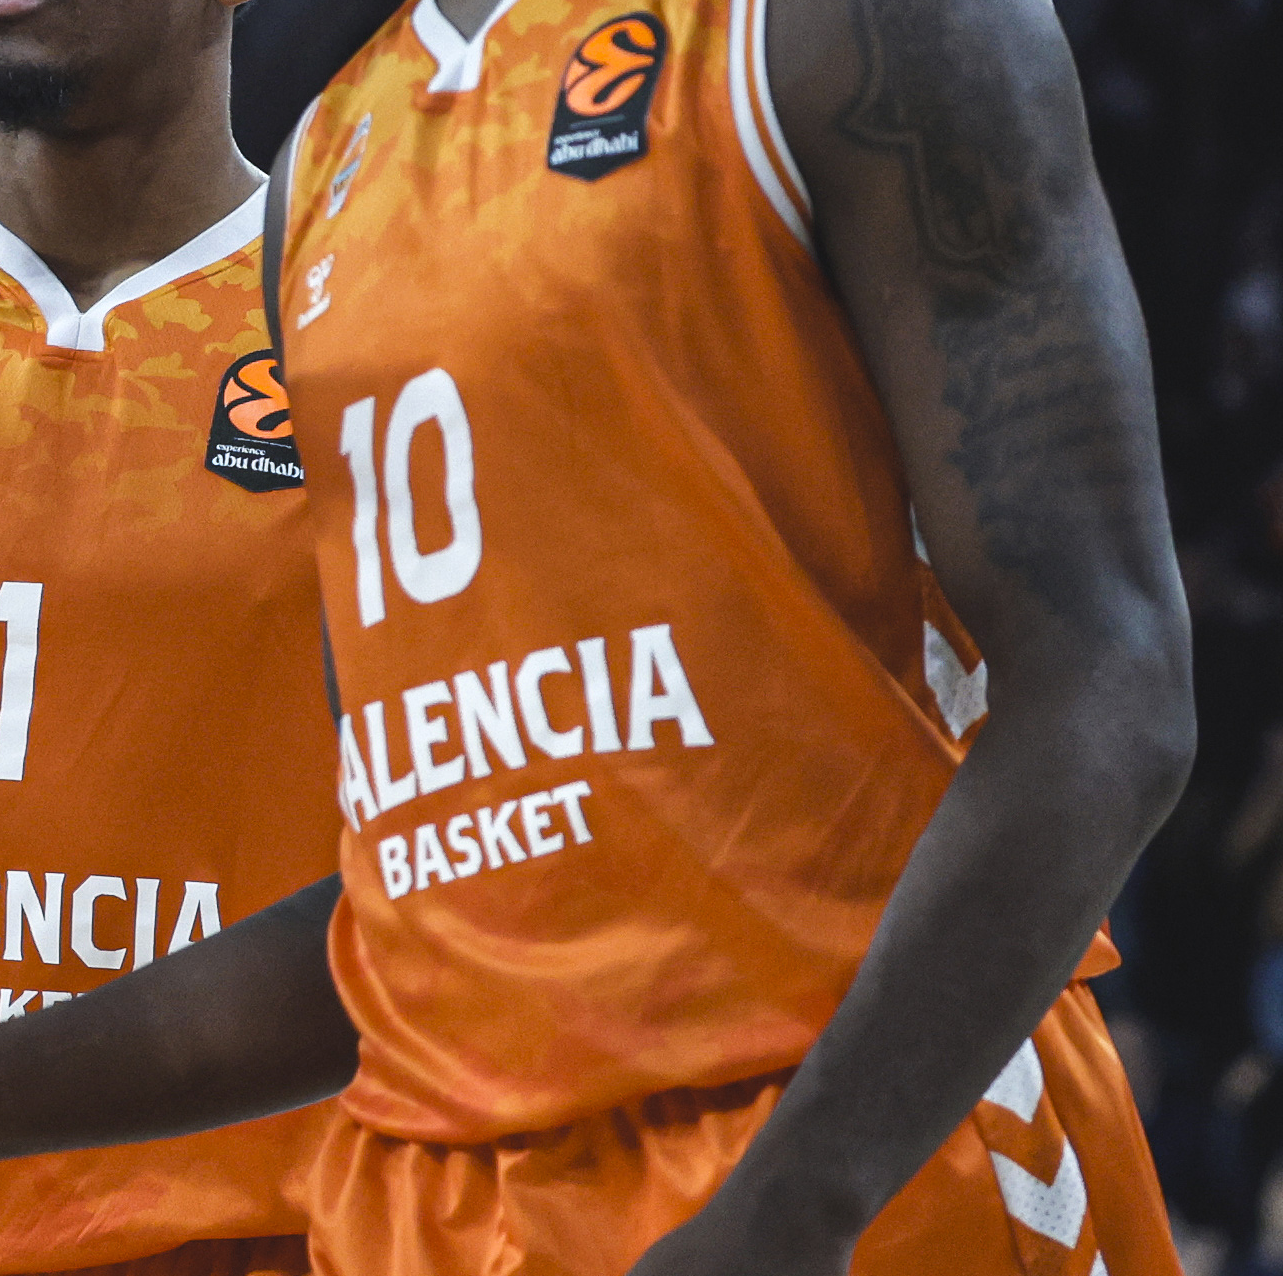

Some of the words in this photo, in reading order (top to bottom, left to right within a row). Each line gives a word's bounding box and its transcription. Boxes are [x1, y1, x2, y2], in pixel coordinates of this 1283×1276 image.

[212, 452, 249, 469] abu
[251, 456, 305, 480] dhabi
[216, 443, 266, 456] experience
[340, 367, 483, 628] 10
[339, 623, 715, 833] ALENCIA
[377, 780, 593, 900] BASKET
